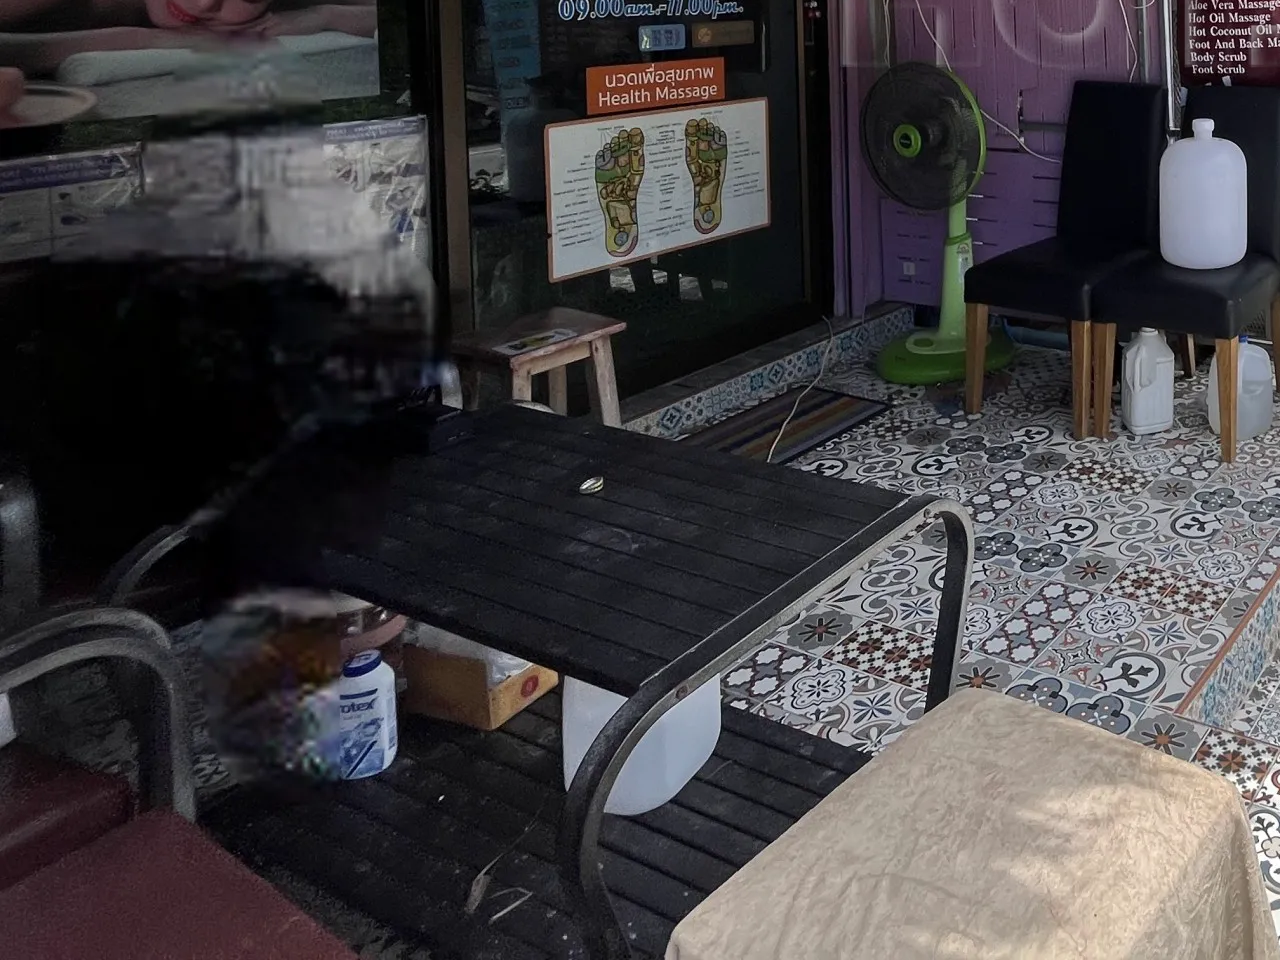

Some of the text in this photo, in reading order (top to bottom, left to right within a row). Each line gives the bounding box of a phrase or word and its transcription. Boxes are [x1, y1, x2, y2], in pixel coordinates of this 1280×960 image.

[1188, 0, 1208, 10] Aloe
[1211, 0, 1235, 10] Vera
[1238, 0, 1280, 11] Massage
[1188, 13, 1206, 24] Hot
[1209, 12, 1225, 23] Oil
[1228, 12, 1271, 25] Massage
[1189, 26, 1206, 37] Hot
[1210, 25, 1252, 36] Coconut
[1256, 24, 1272, 35] Oil
[1189, 39, 1211, 50] Foot
[1215, 38, 1236, 49] And
[1239, 37, 1264, 49] Back
[1190, 52, 1215, 65] Body
[1218, 51, 1247, 62] Scrub
[605, 63, 714, 87] นวดเพื่อสุขภาพ
[1192, 64, 1214, 75] Foot
[1217, 64, 1246, 74] Scrub
[598, 83, 718, 107] Health Massage
